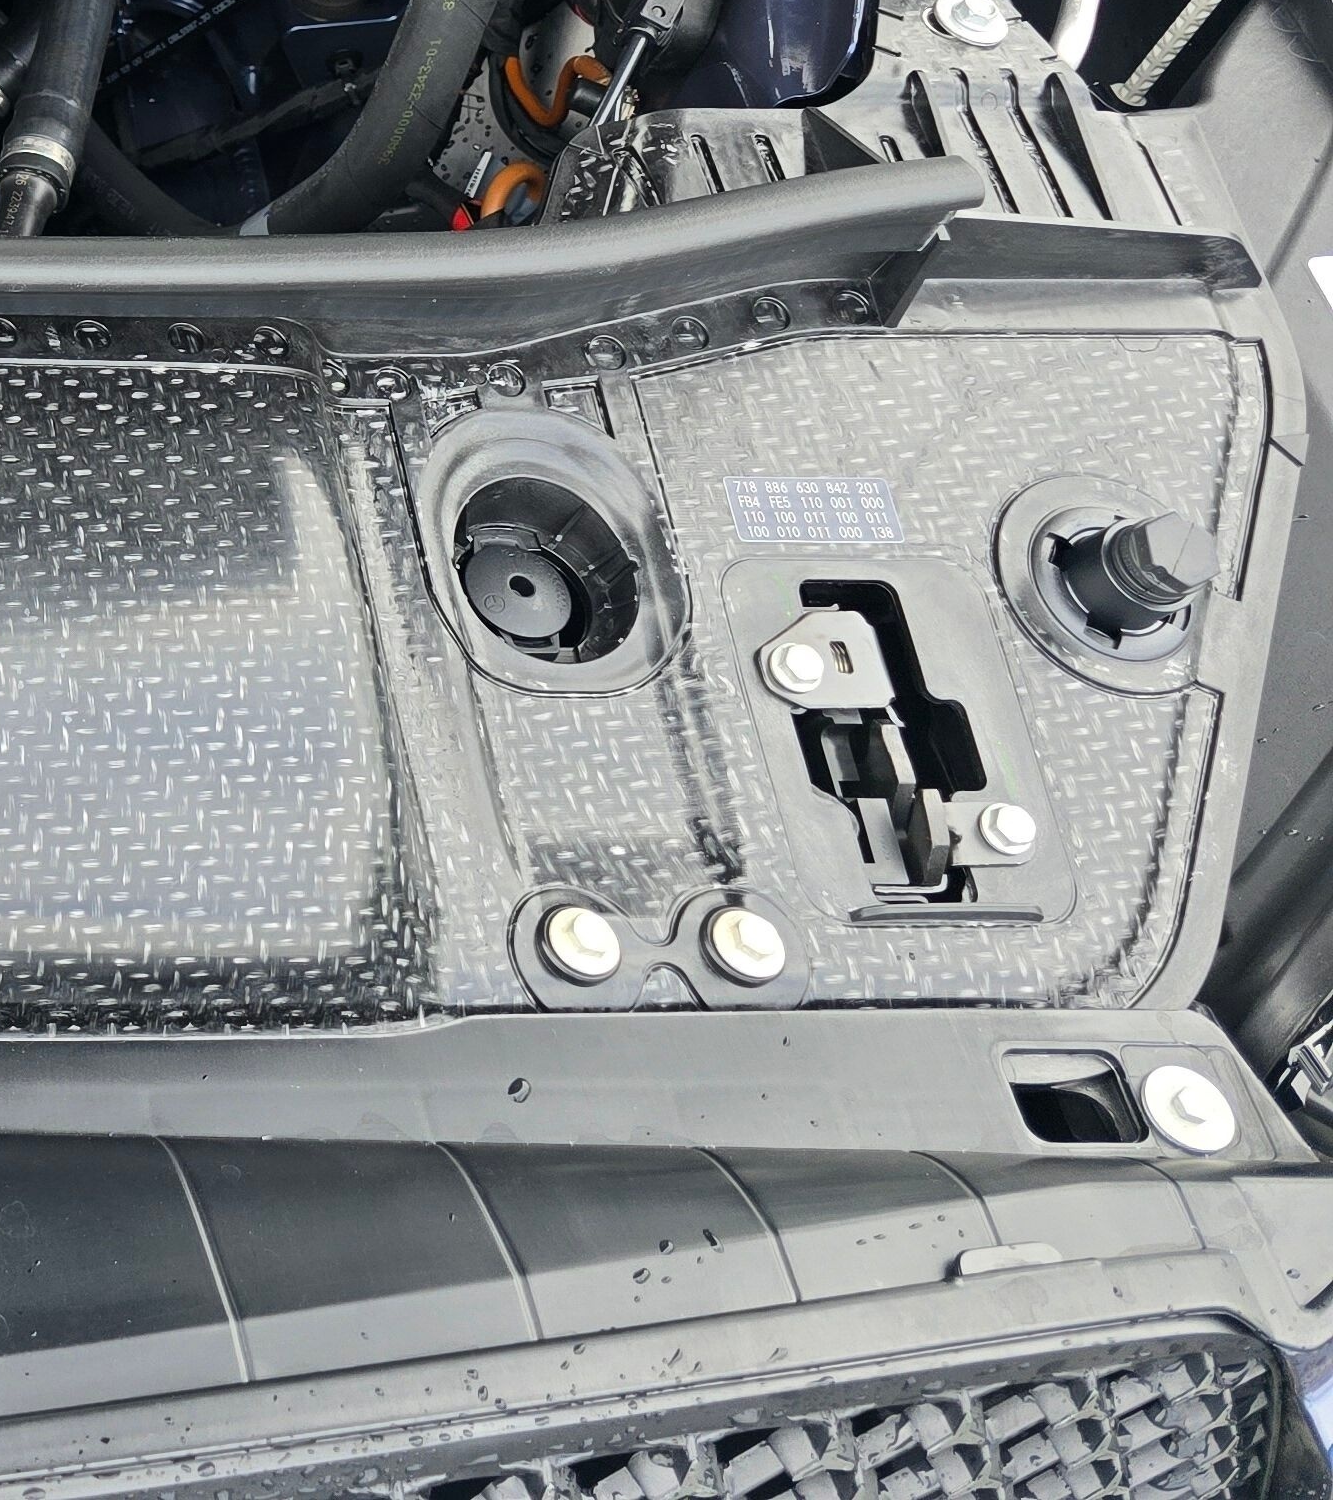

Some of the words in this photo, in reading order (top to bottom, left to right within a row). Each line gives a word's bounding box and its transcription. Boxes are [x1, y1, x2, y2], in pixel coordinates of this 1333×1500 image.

[15, 173, 30, 186] 26
[732, 480, 758, 494] 718
[764, 480, 789, 494] 886
[795, 481, 820, 494] 630
[825, 481, 850, 495] 842
[855, 481, 881, 495] 201
[737, 495, 761, 509] FB4
[768, 495, 792, 509] FE5
[800, 496, 823, 509] 110
[829, 496, 854, 510] 001
[860, 496, 885, 510] 000
[743, 510, 766, 523] 110
[773, 511, 797, 524] 100
[803, 511, 827, 524] 011
[835, 511, 858, 524] 100
[864, 511, 890, 525] 011
[747, 525, 770, 538] 100
[776, 525, 801, 539] 010
[807, 526, 832, 539] 011
[838, 526, 863, 539] 000
[870, 526, 895, 539] 138
